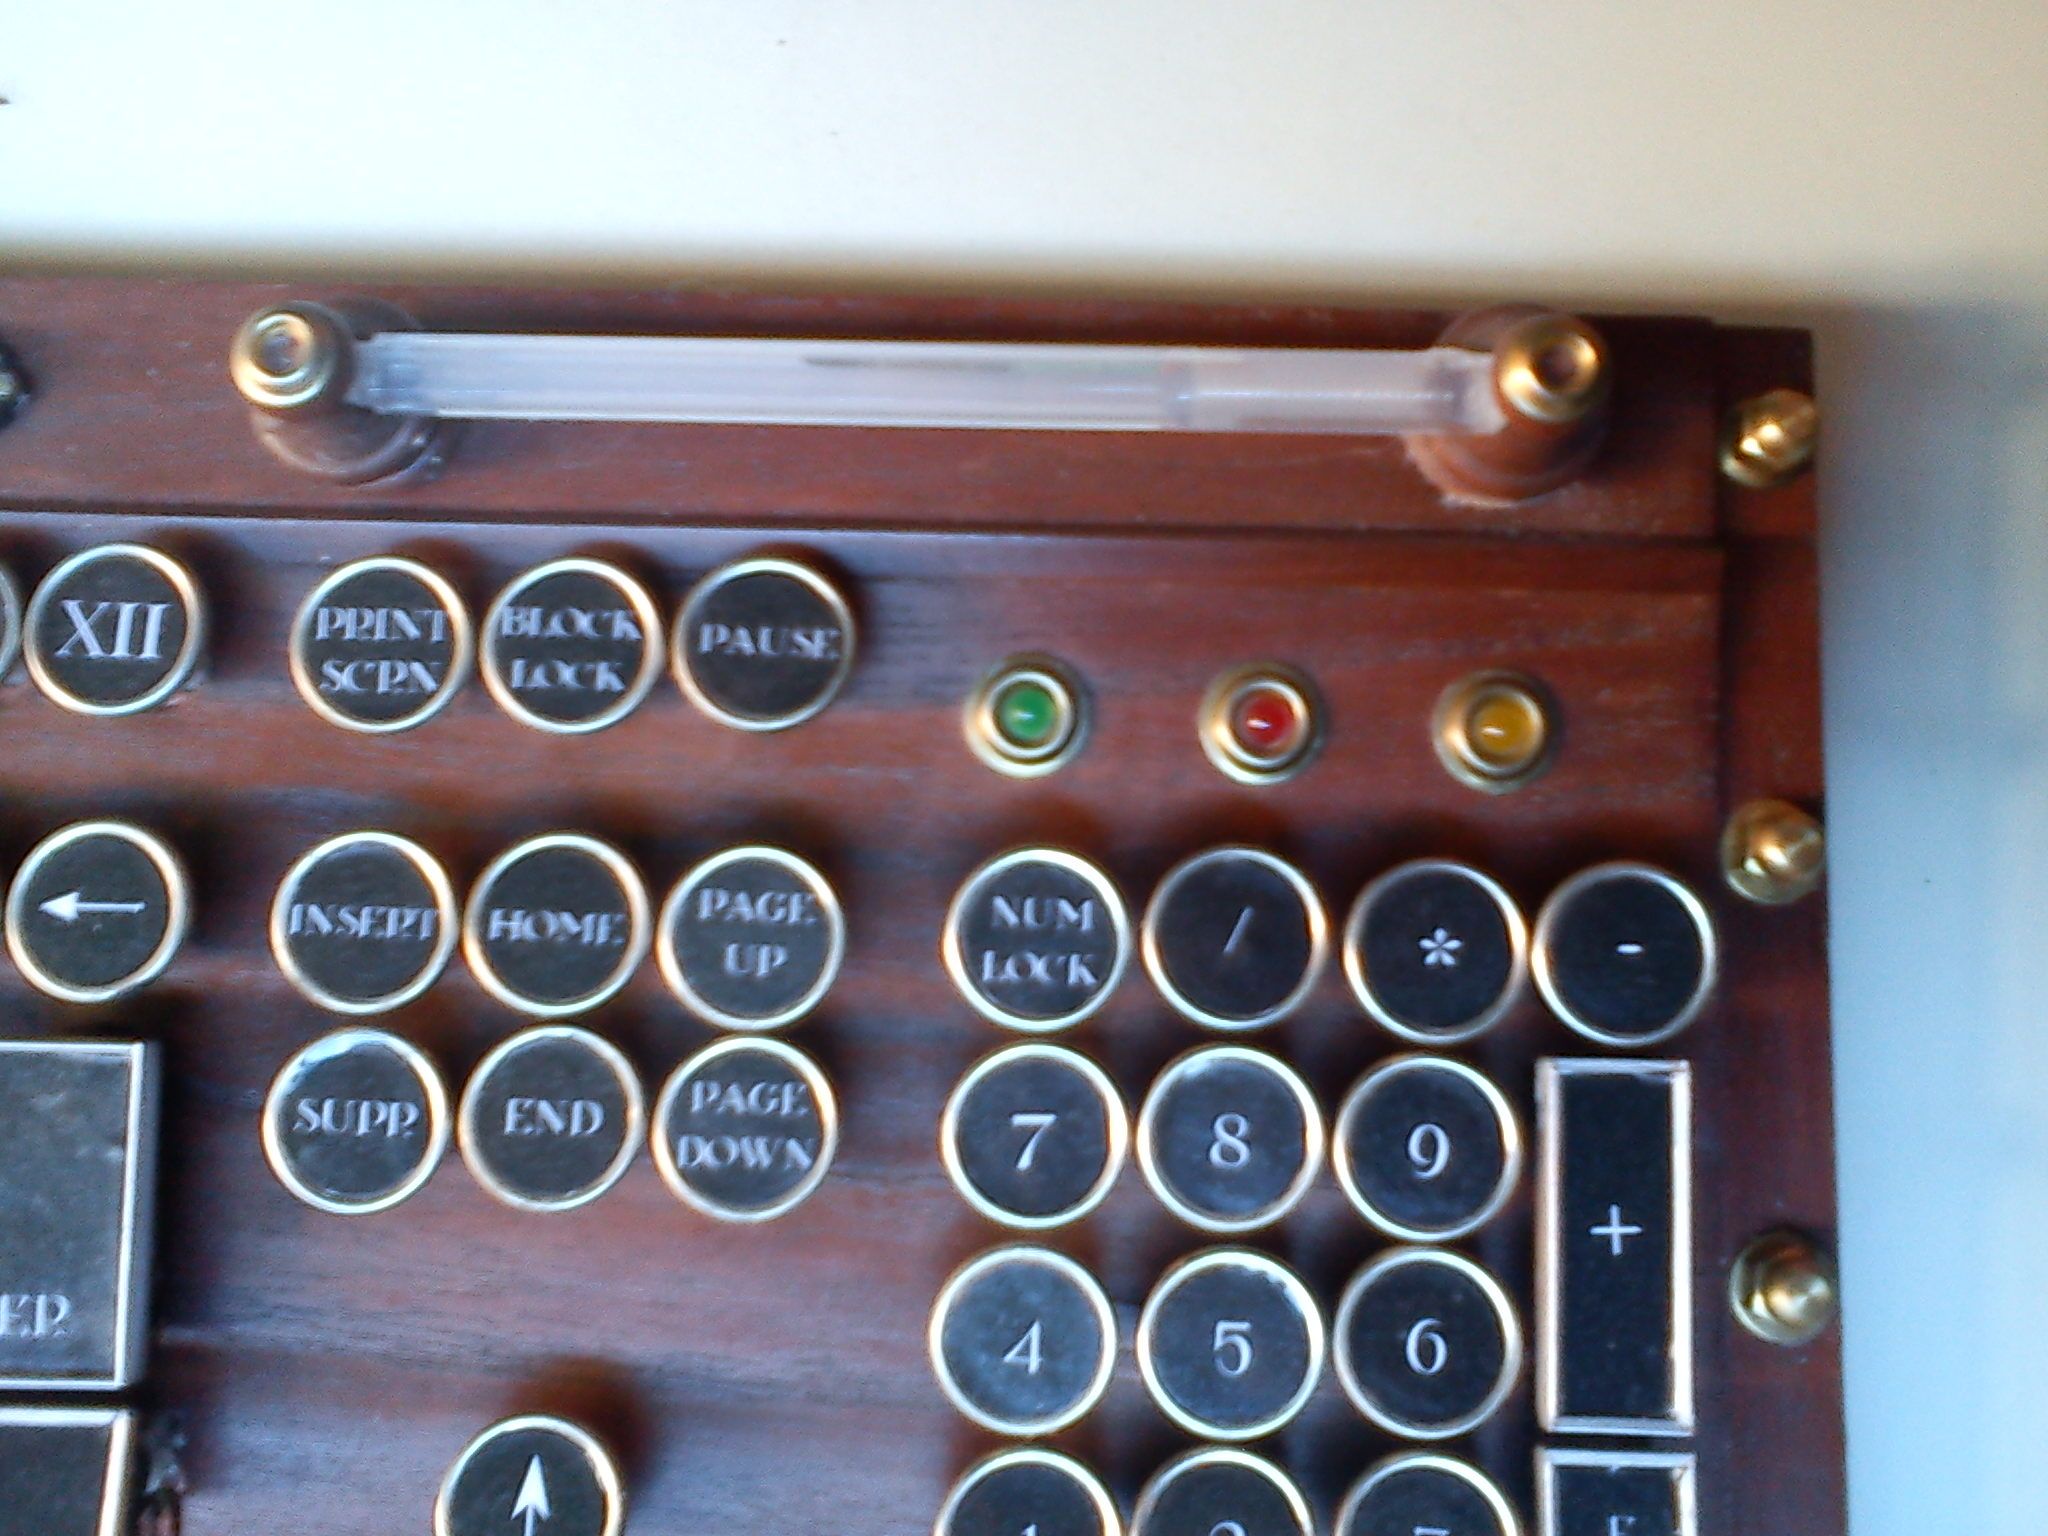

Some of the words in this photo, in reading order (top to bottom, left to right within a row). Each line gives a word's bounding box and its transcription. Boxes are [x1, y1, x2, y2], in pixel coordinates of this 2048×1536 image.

[57, 599, 171, 661] XII
[315, 607, 444, 643] PRINT
[500, 605, 642, 640] BLOCK
[697, 622, 842, 660] PAUSE
[319, 659, 442, 694] SCRN
[510, 658, 625, 691] LOCK
[290, 903, 438, 941] INSERT
[697, 886, 818, 926] PAGE
[990, 894, 1093, 934] NUM
[487, 909, 624, 946] HOME
[724, 939, 788, 976] UP
[982, 949, 1098, 988] LOCK
[503, 1097, 605, 1138] END
[690, 1080, 808, 1117] PAGE
[676, 1134, 816, 1173] DOWN
[1010, 1112, 1057, 1172] 7
[1208, 1112, 1252, 1168] 8
[1406, 1123, 1449, 1181] 9
[1003, 1319, 1044, 1375] 4
[1212, 1320, 1252, 1378] 5
[1405, 1317, 1448, 1376] 6
